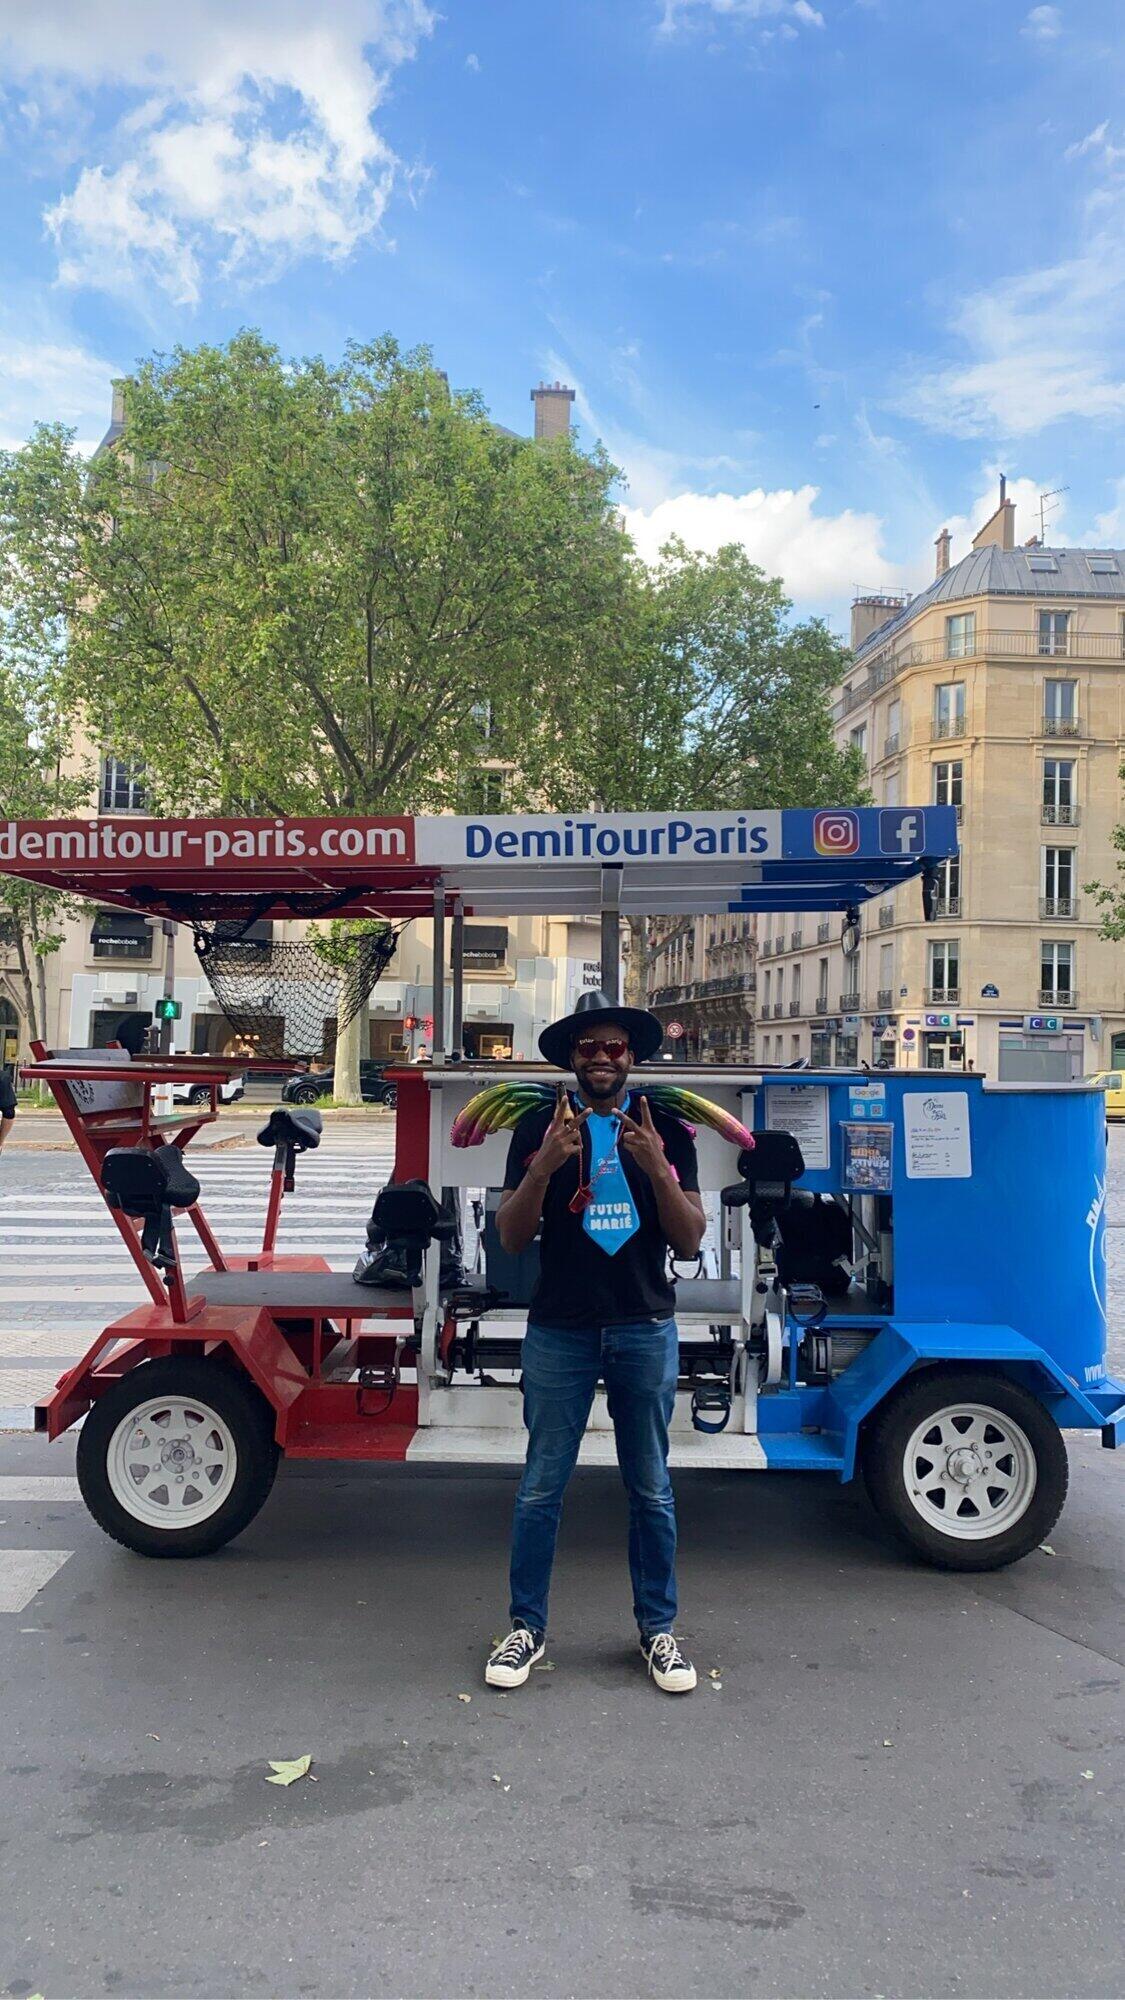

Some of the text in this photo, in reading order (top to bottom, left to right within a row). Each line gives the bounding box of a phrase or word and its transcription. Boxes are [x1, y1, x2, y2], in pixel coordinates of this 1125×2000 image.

[0, 819, 406, 867] demitour-paris.com
[465, 816, 769, 858] DemiTourParis
[589, 1203, 632, 1215] FUTUR
[590, 1214, 633, 1230] MARIÉ
